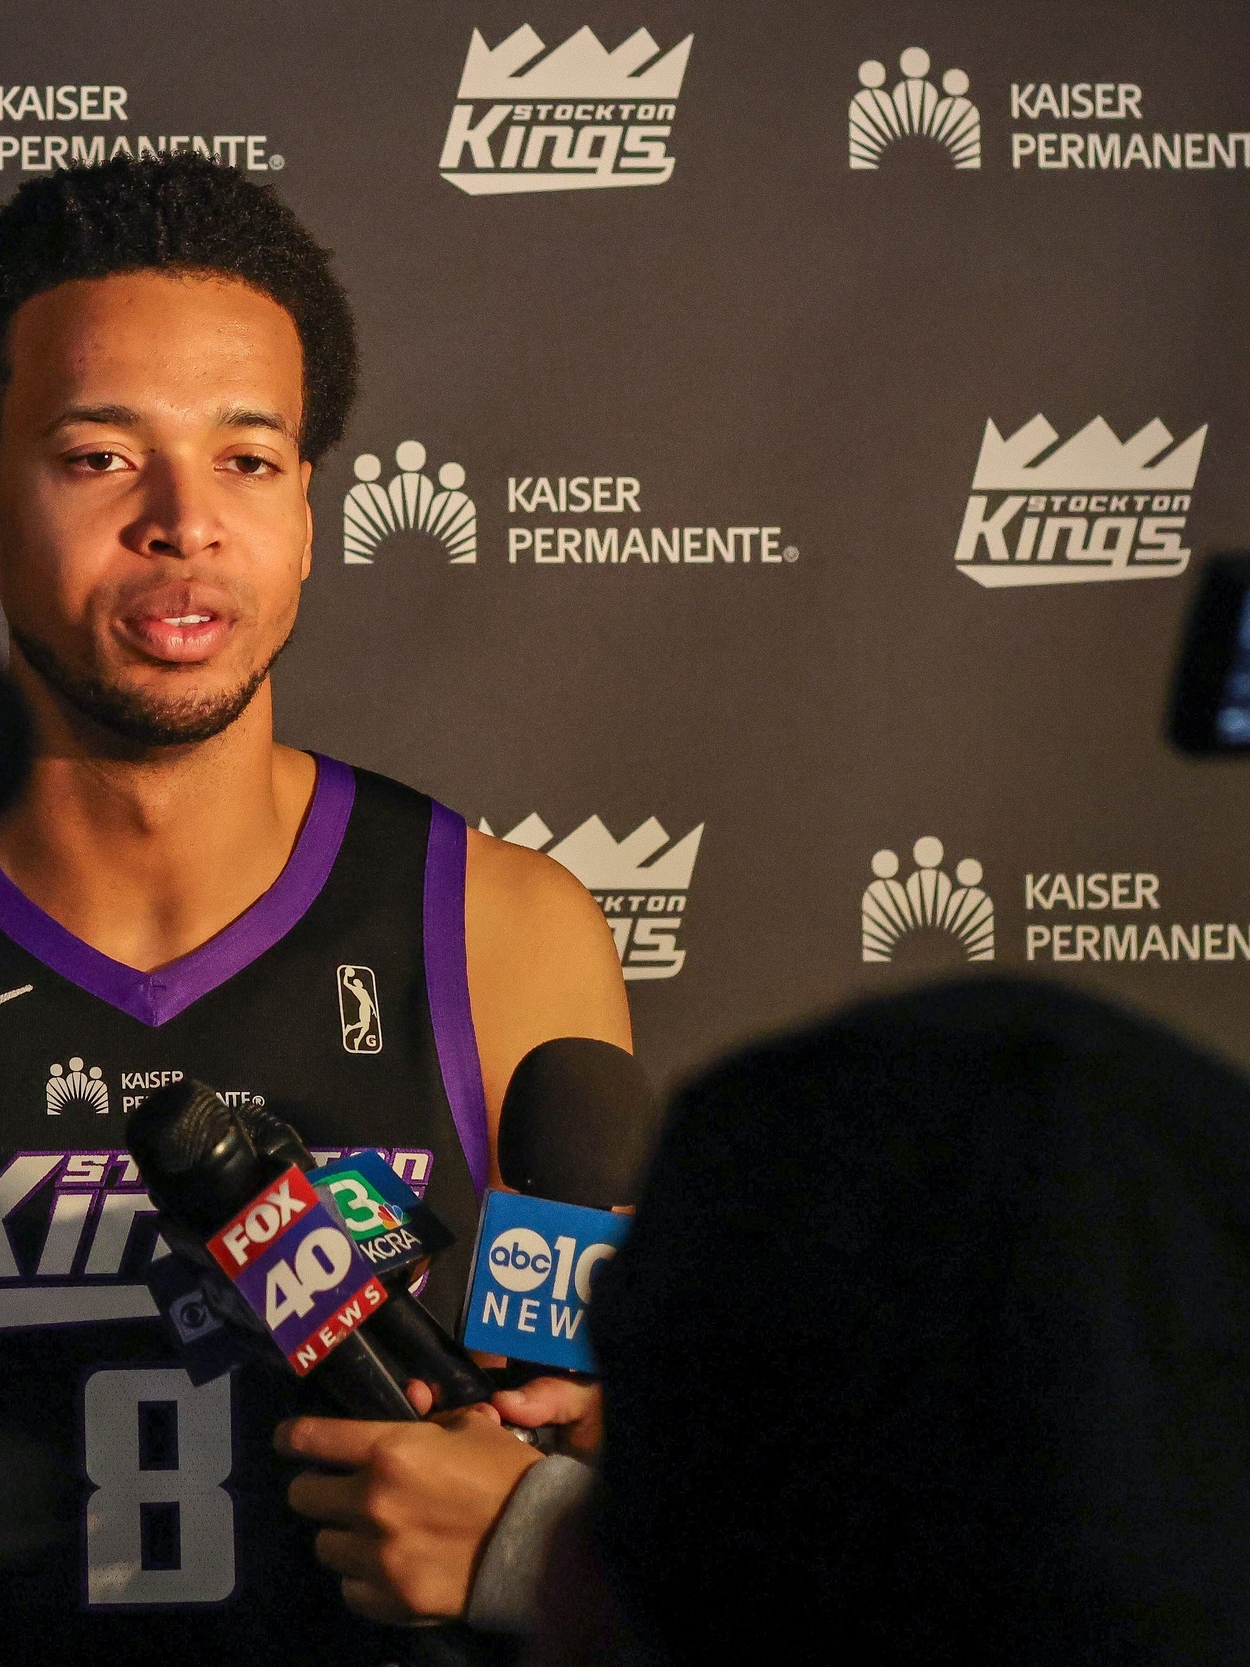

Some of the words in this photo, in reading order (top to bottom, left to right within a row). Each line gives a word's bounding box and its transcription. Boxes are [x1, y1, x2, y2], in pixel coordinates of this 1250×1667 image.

[512, 103, 677, 121] STOCKTON
[1010, 82, 1143, 120] KAISER
[438, 103, 676, 178] Kings
[507, 476, 642, 513] KAISER
[1026, 494, 1193, 513] STOCKTON
[953, 494, 1192, 570] Kings
[1024, 872, 1161, 910] KAISER
[365, 1034, 377, 1047] G
[222, 1179, 308, 1267] FOX
[328, 1178, 382, 1233] 3
[359, 1227, 422, 1264] KCRA
[490, 1241, 551, 1275] abc
[264, 1226, 353, 1332] 40
[295, 1284, 381, 1370] NEWS
[481, 1290, 585, 1341] NEW
[83, 1367, 237, 1605] 8
